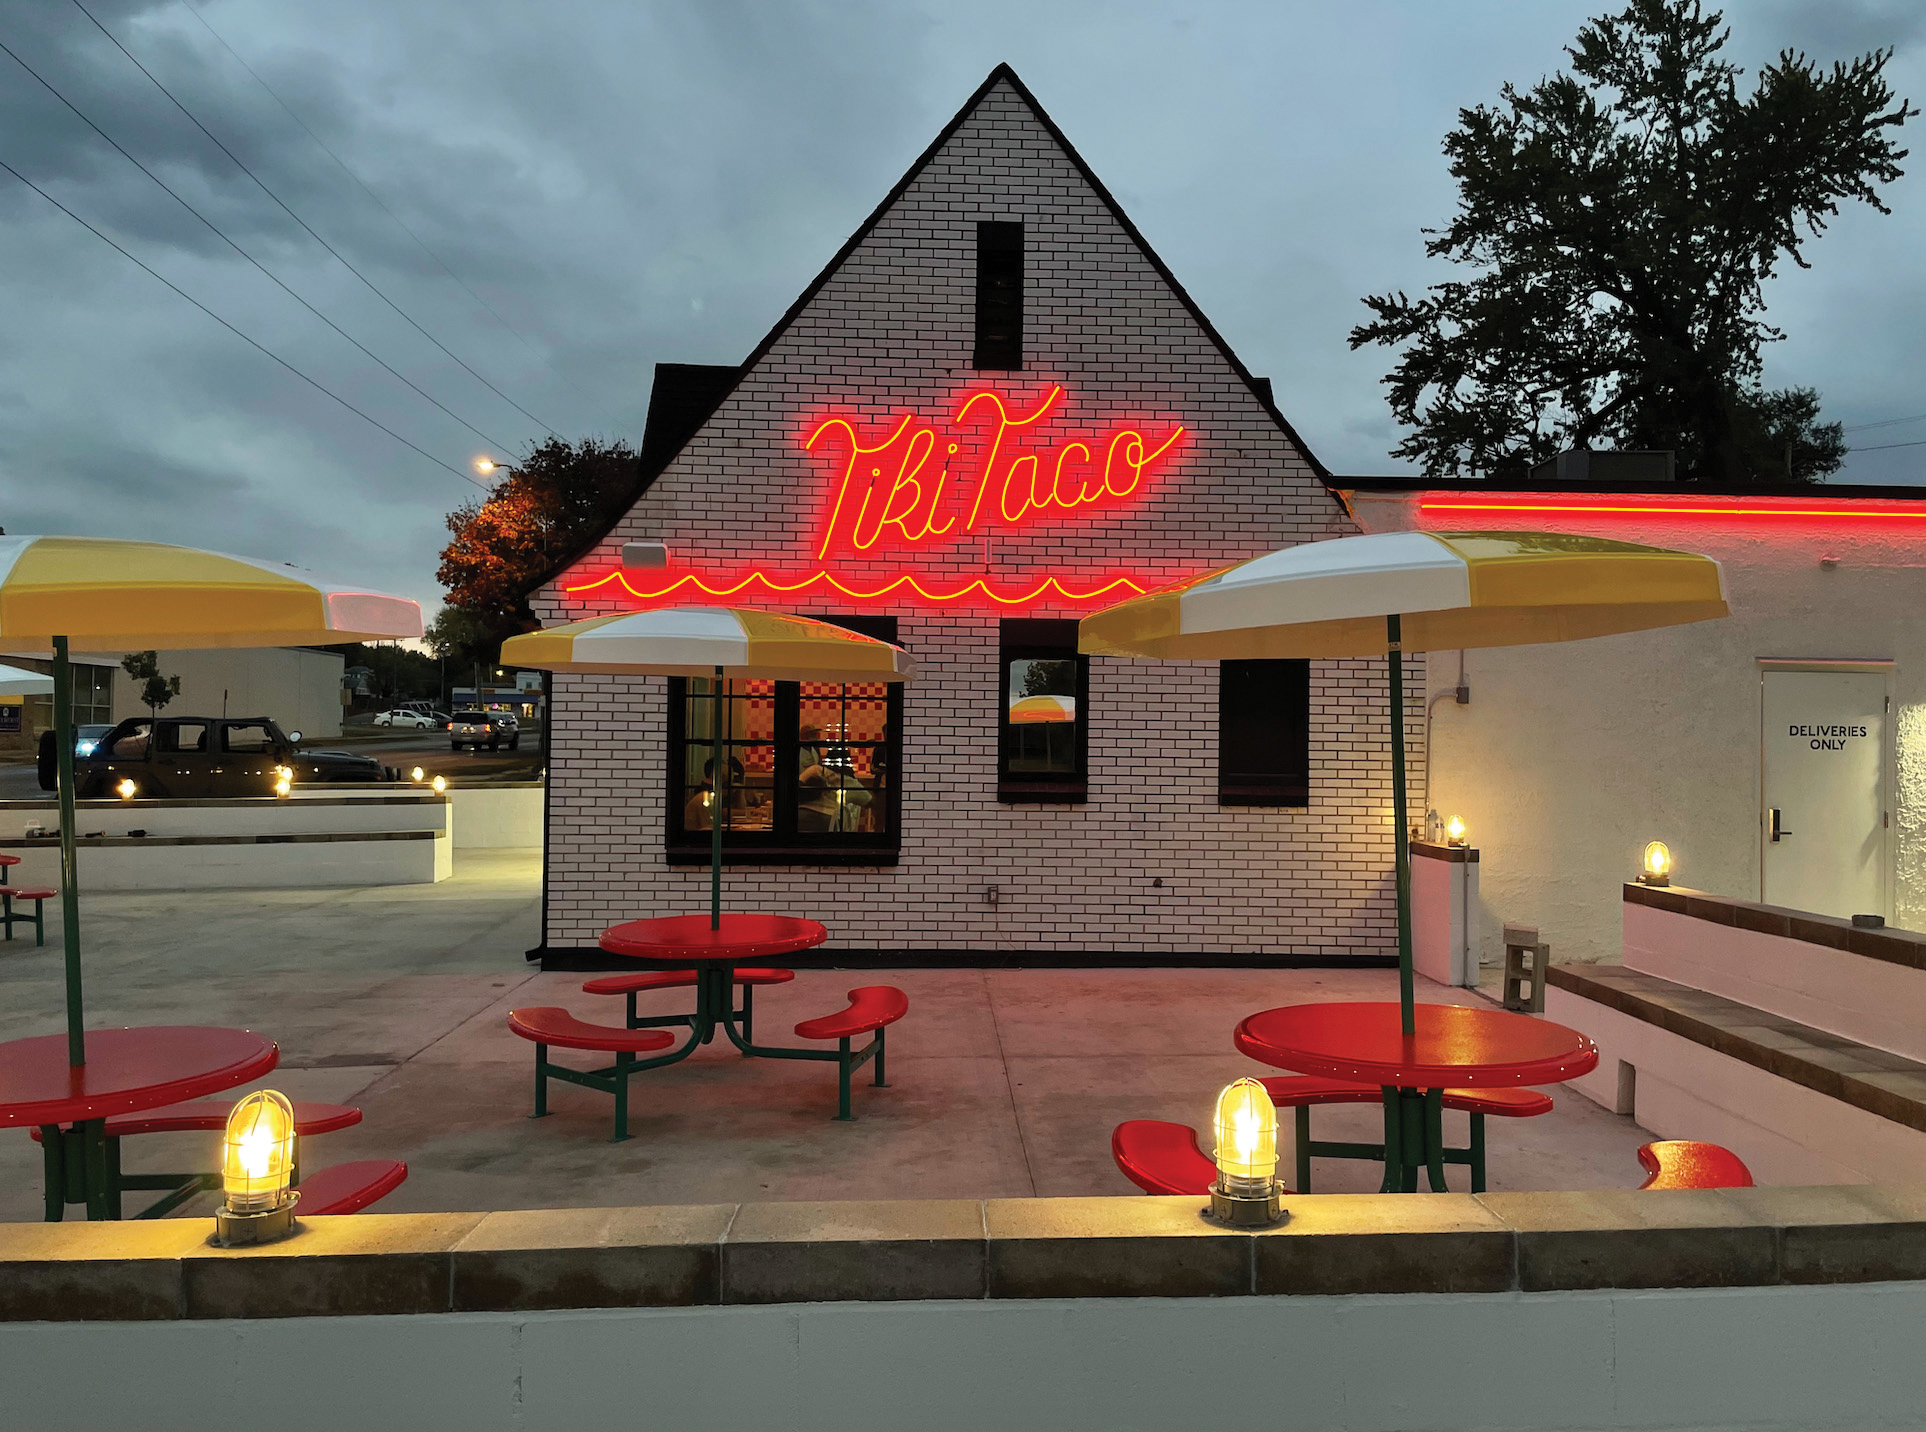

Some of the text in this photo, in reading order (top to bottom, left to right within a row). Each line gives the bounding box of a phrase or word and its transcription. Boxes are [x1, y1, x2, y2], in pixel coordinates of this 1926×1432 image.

[806, 385, 1184, 560] Tiki Taco
[1789, 725, 1867, 737] DELIVERIES
[1810, 739, 1846, 750] ONLY
